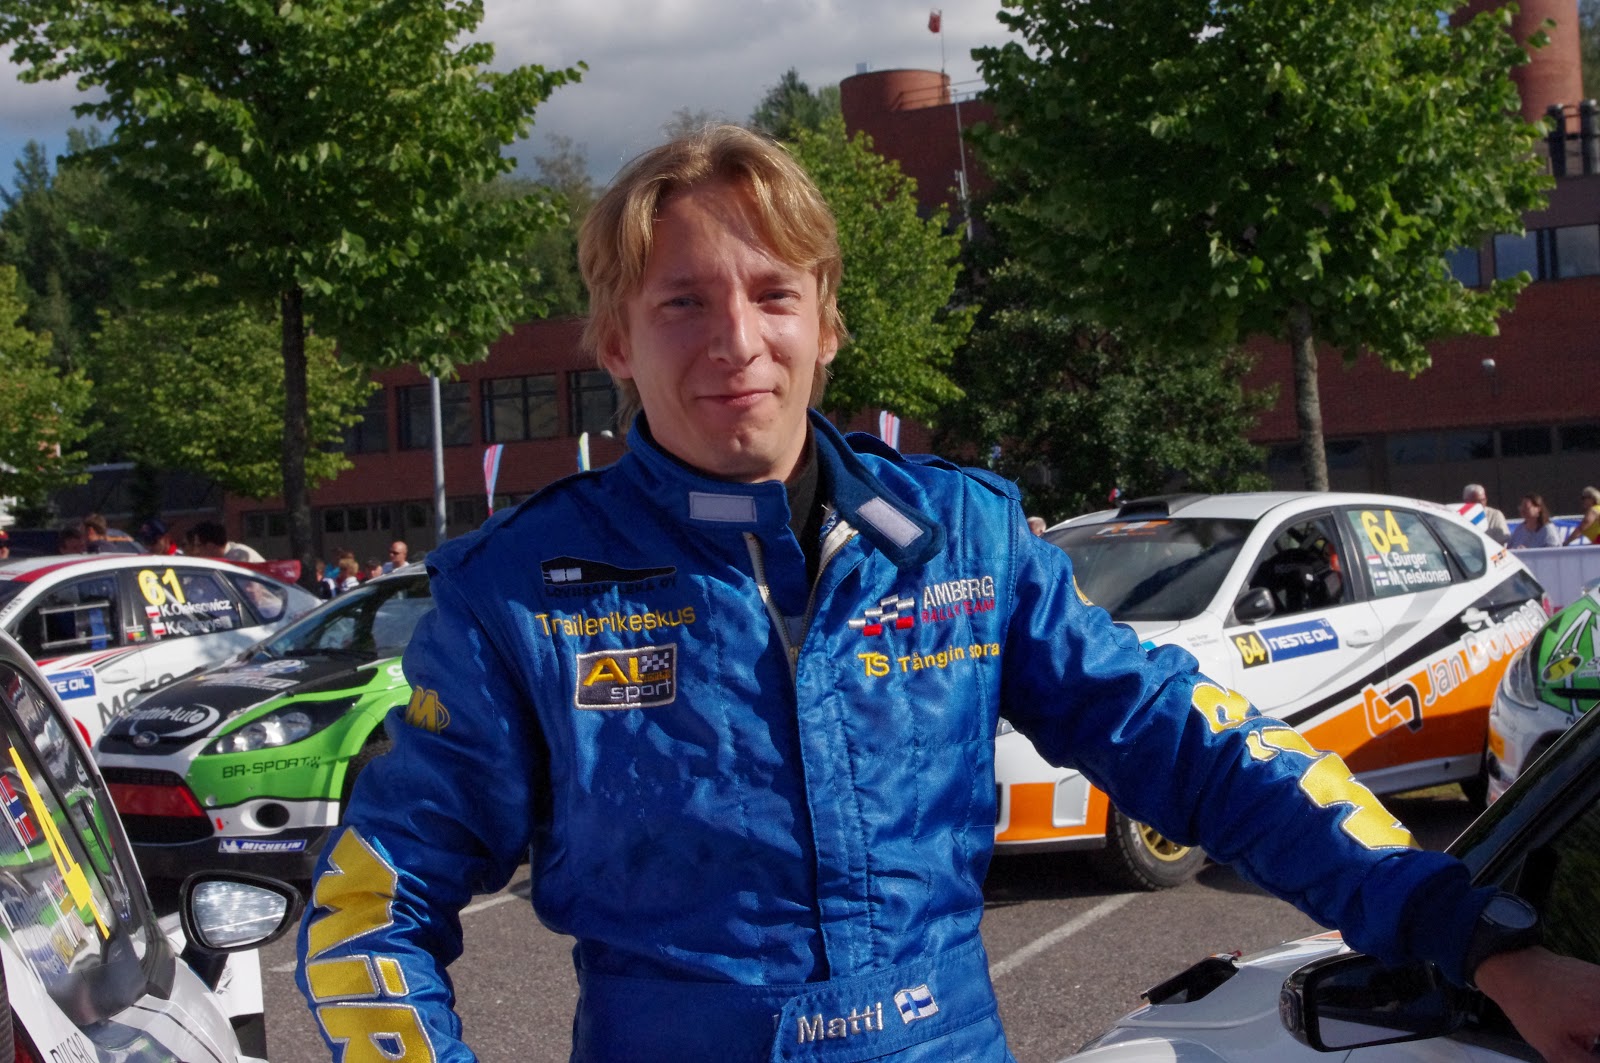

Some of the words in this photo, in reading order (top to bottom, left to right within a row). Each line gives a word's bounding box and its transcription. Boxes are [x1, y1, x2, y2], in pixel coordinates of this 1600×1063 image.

[1360, 509, 1410, 553] 64
[1381, 552, 1428, 569] K.Burger
[138, 568, 186, 606] 61
[1388, 568, 1452, 586] M.Teiskonen
[923, 575, 995, 610] AMBERG
[535, 606, 696, 636] Trailerikeskus
[1235, 633, 1266, 665] 64
[1268, 631, 1316, 651] NESTE
[1311, 628, 1334, 642] OIL
[857, 651, 891, 677] TS
[68, 678, 91, 691] OIL
[610, 679, 672, 703] sport
[1425, 652, 1468, 706] Jan
[222, 756, 311, 779] BR-SPORT
[241, 841, 302, 851] MICHELIN
[796, 1001, 885, 1045] Matti
